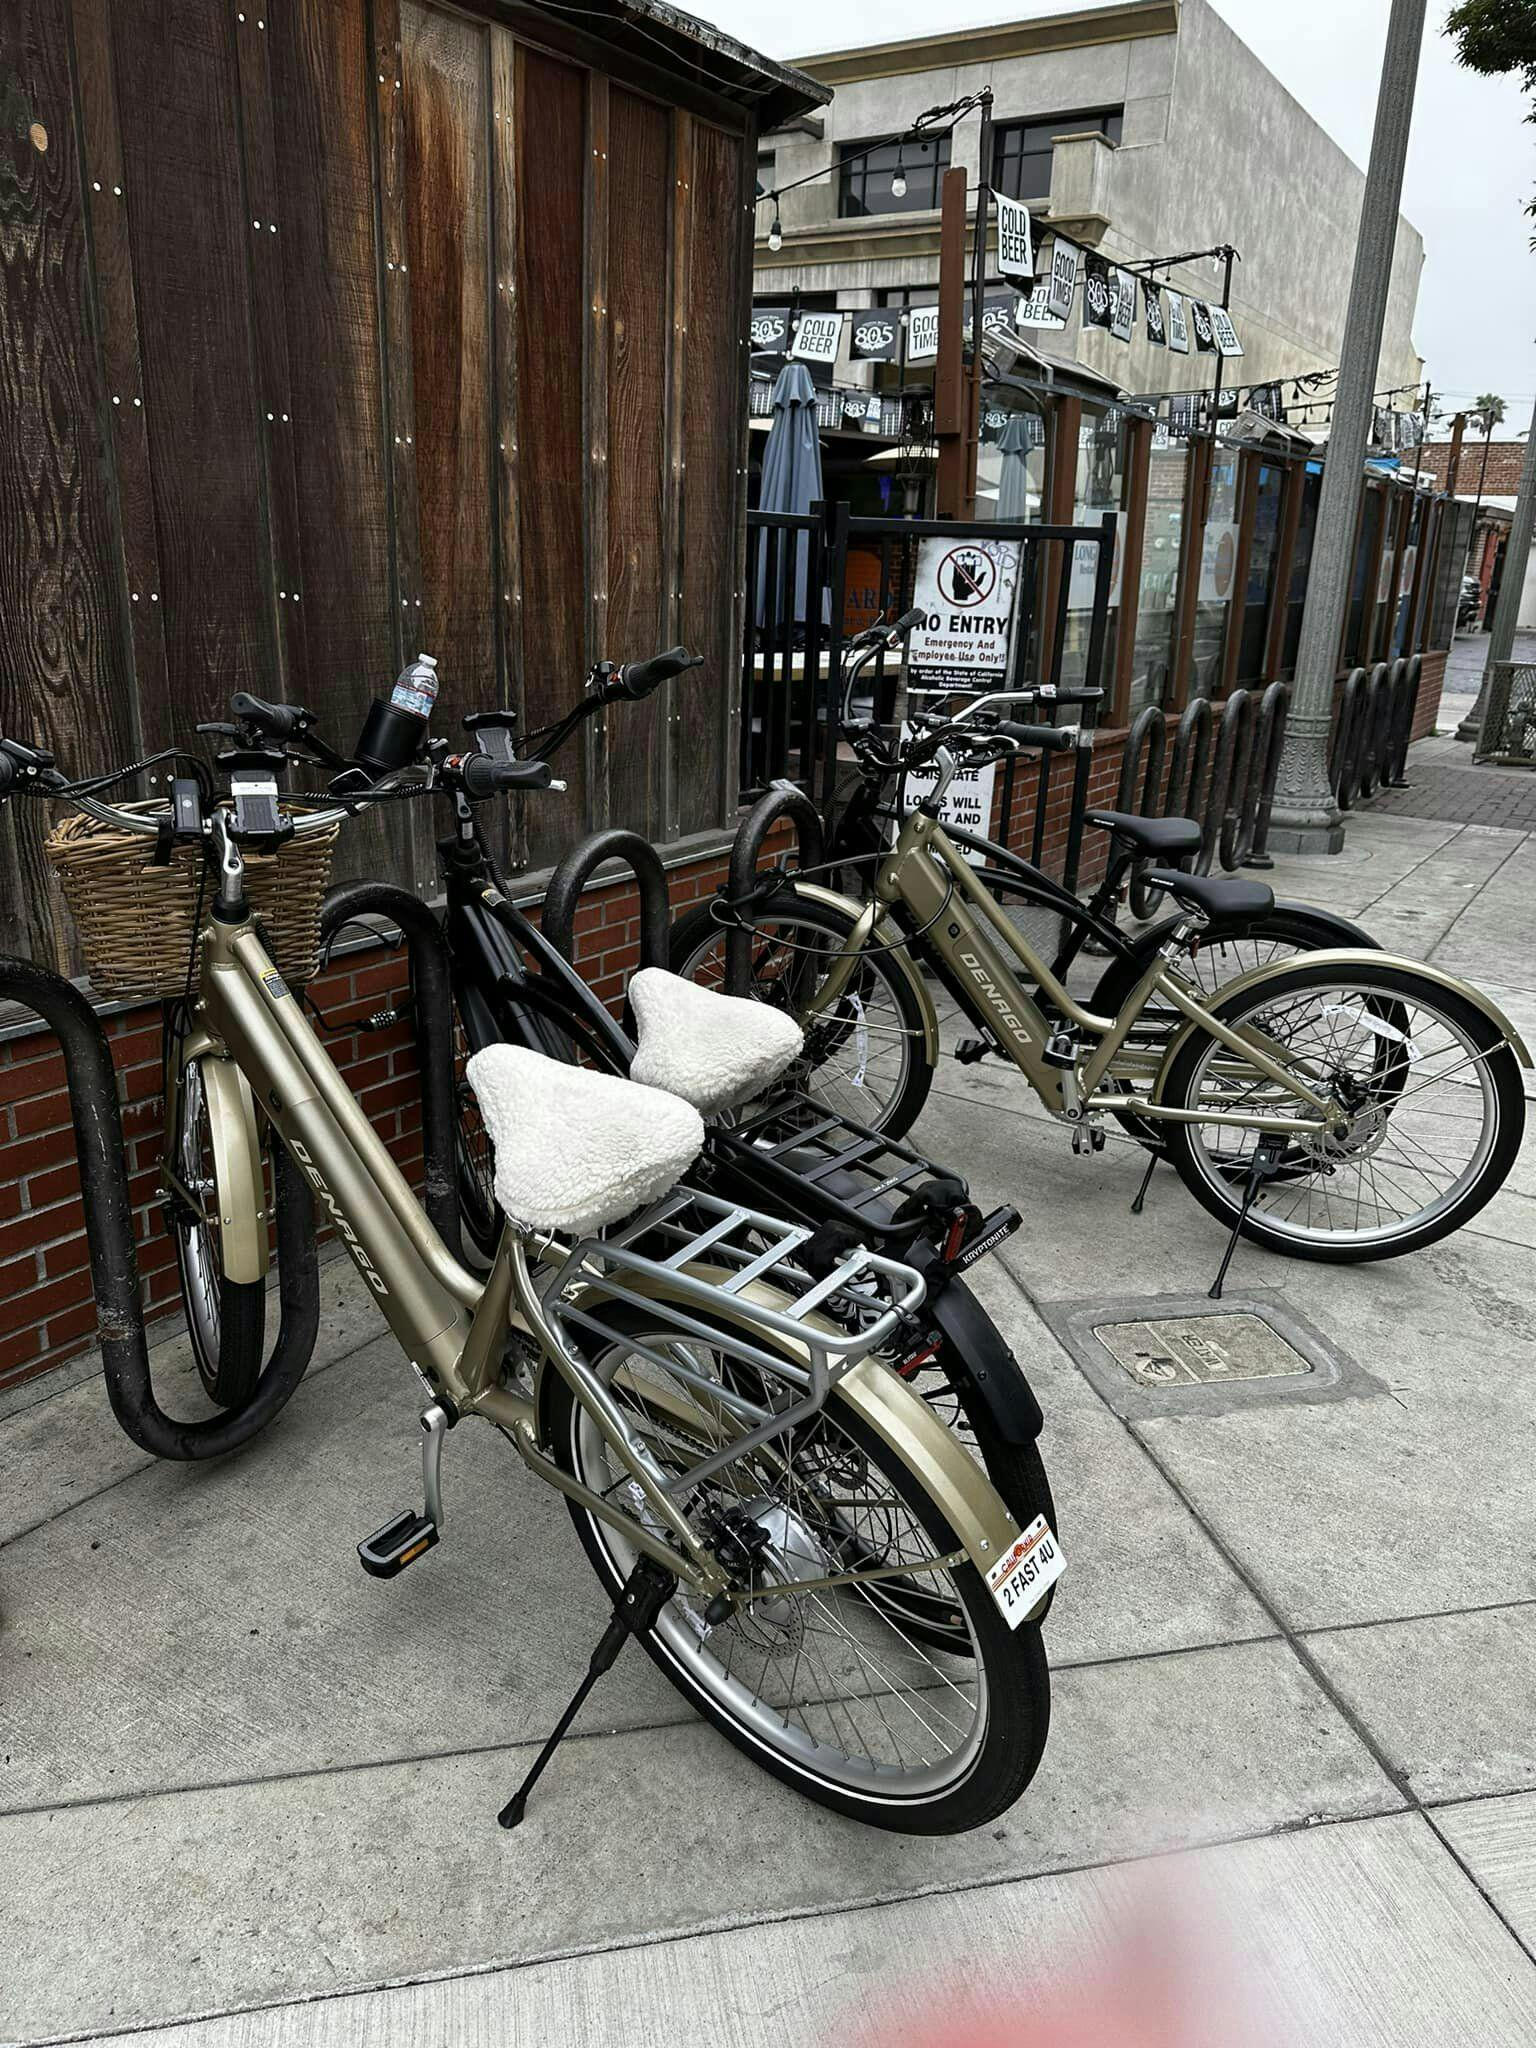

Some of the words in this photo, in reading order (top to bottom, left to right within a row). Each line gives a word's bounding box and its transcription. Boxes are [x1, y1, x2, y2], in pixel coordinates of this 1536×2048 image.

[1001, 205, 1026, 237] COLD
[1001, 232, 1028, 265] BEER
[1054, 251, 1075, 284] GOOD
[1087, 278, 1109, 308] 805
[751, 319, 785, 339] 805
[803, 319, 836, 338] COLD
[913, 314, 939, 334] GOO
[854, 324, 894, 346] 805
[913, 332, 939, 351] TIME
[799, 335, 833, 355] BEER
[844, 402, 866, 417] 805
[984, 411, 1008, 425] 805
[949, 615, 1008, 634] ENTRY
[924, 636, 974, 650] Emergency
[976, 639, 996, 650] And
[958, 651, 976, 662] Use
[945, 675, 971, 683] Beverage
[977, 671, 1004, 679] California
[951, 769, 980, 782] ATE
[953, 797, 982, 809] WILL
[954, 813, 982, 825] AND
[959, 952, 1033, 1044] DENAGO
[289, 1138, 390, 1295] DENAGO
[962, 1225, 1010, 1264] KRYPTONITE
[1003, 1587, 1015, 1607] 2
[1010, 1555, 1040, 1598] FAST
[1038, 1539, 1055, 1565] 4U
